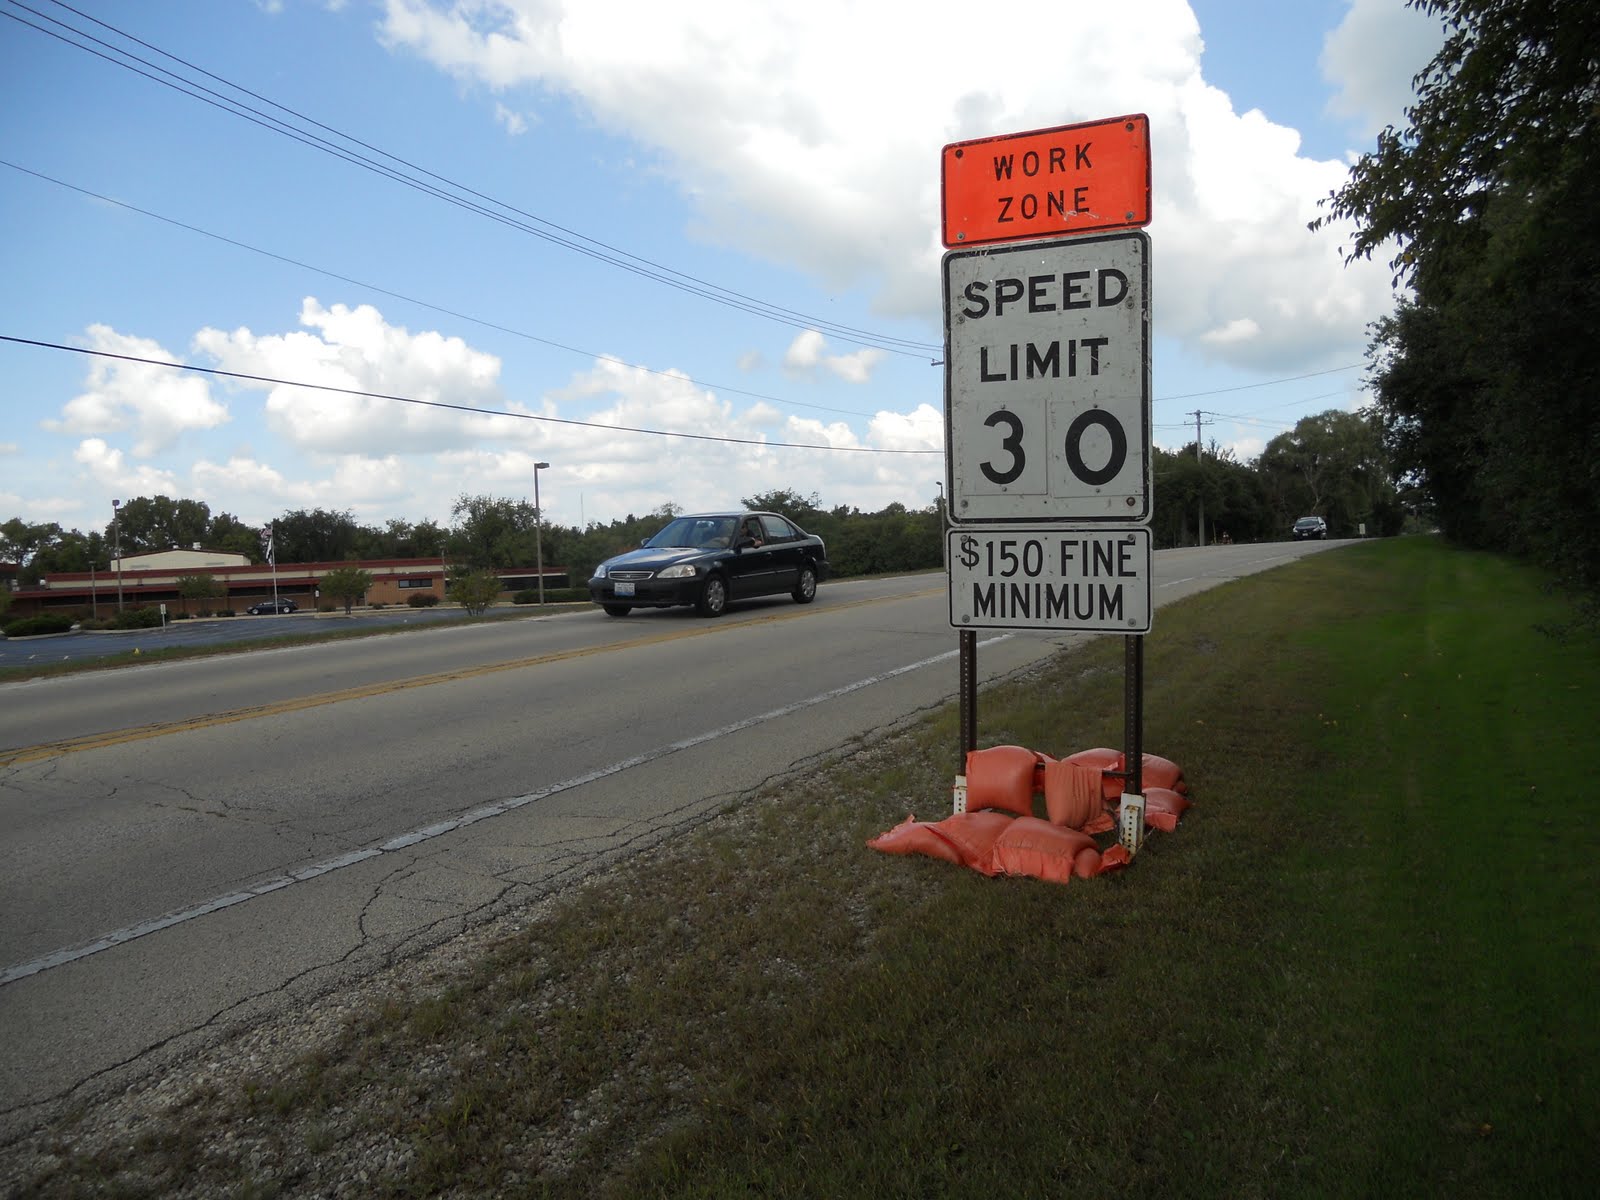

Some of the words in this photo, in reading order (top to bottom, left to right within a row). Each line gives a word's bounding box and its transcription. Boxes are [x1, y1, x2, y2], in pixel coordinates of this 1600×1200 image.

[994, 142, 1092, 181] WORK
[998, 187, 1090, 223] ZONE
[962, 268, 1129, 319] SPEED
[980, 337, 1109, 382] LIMIT
[980, 409, 1128, 486] 30
[960, 536, 1044, 577] $150
[1060, 540, 1136, 577] FINE
[973, 582, 1124, 621] MINIMUM
